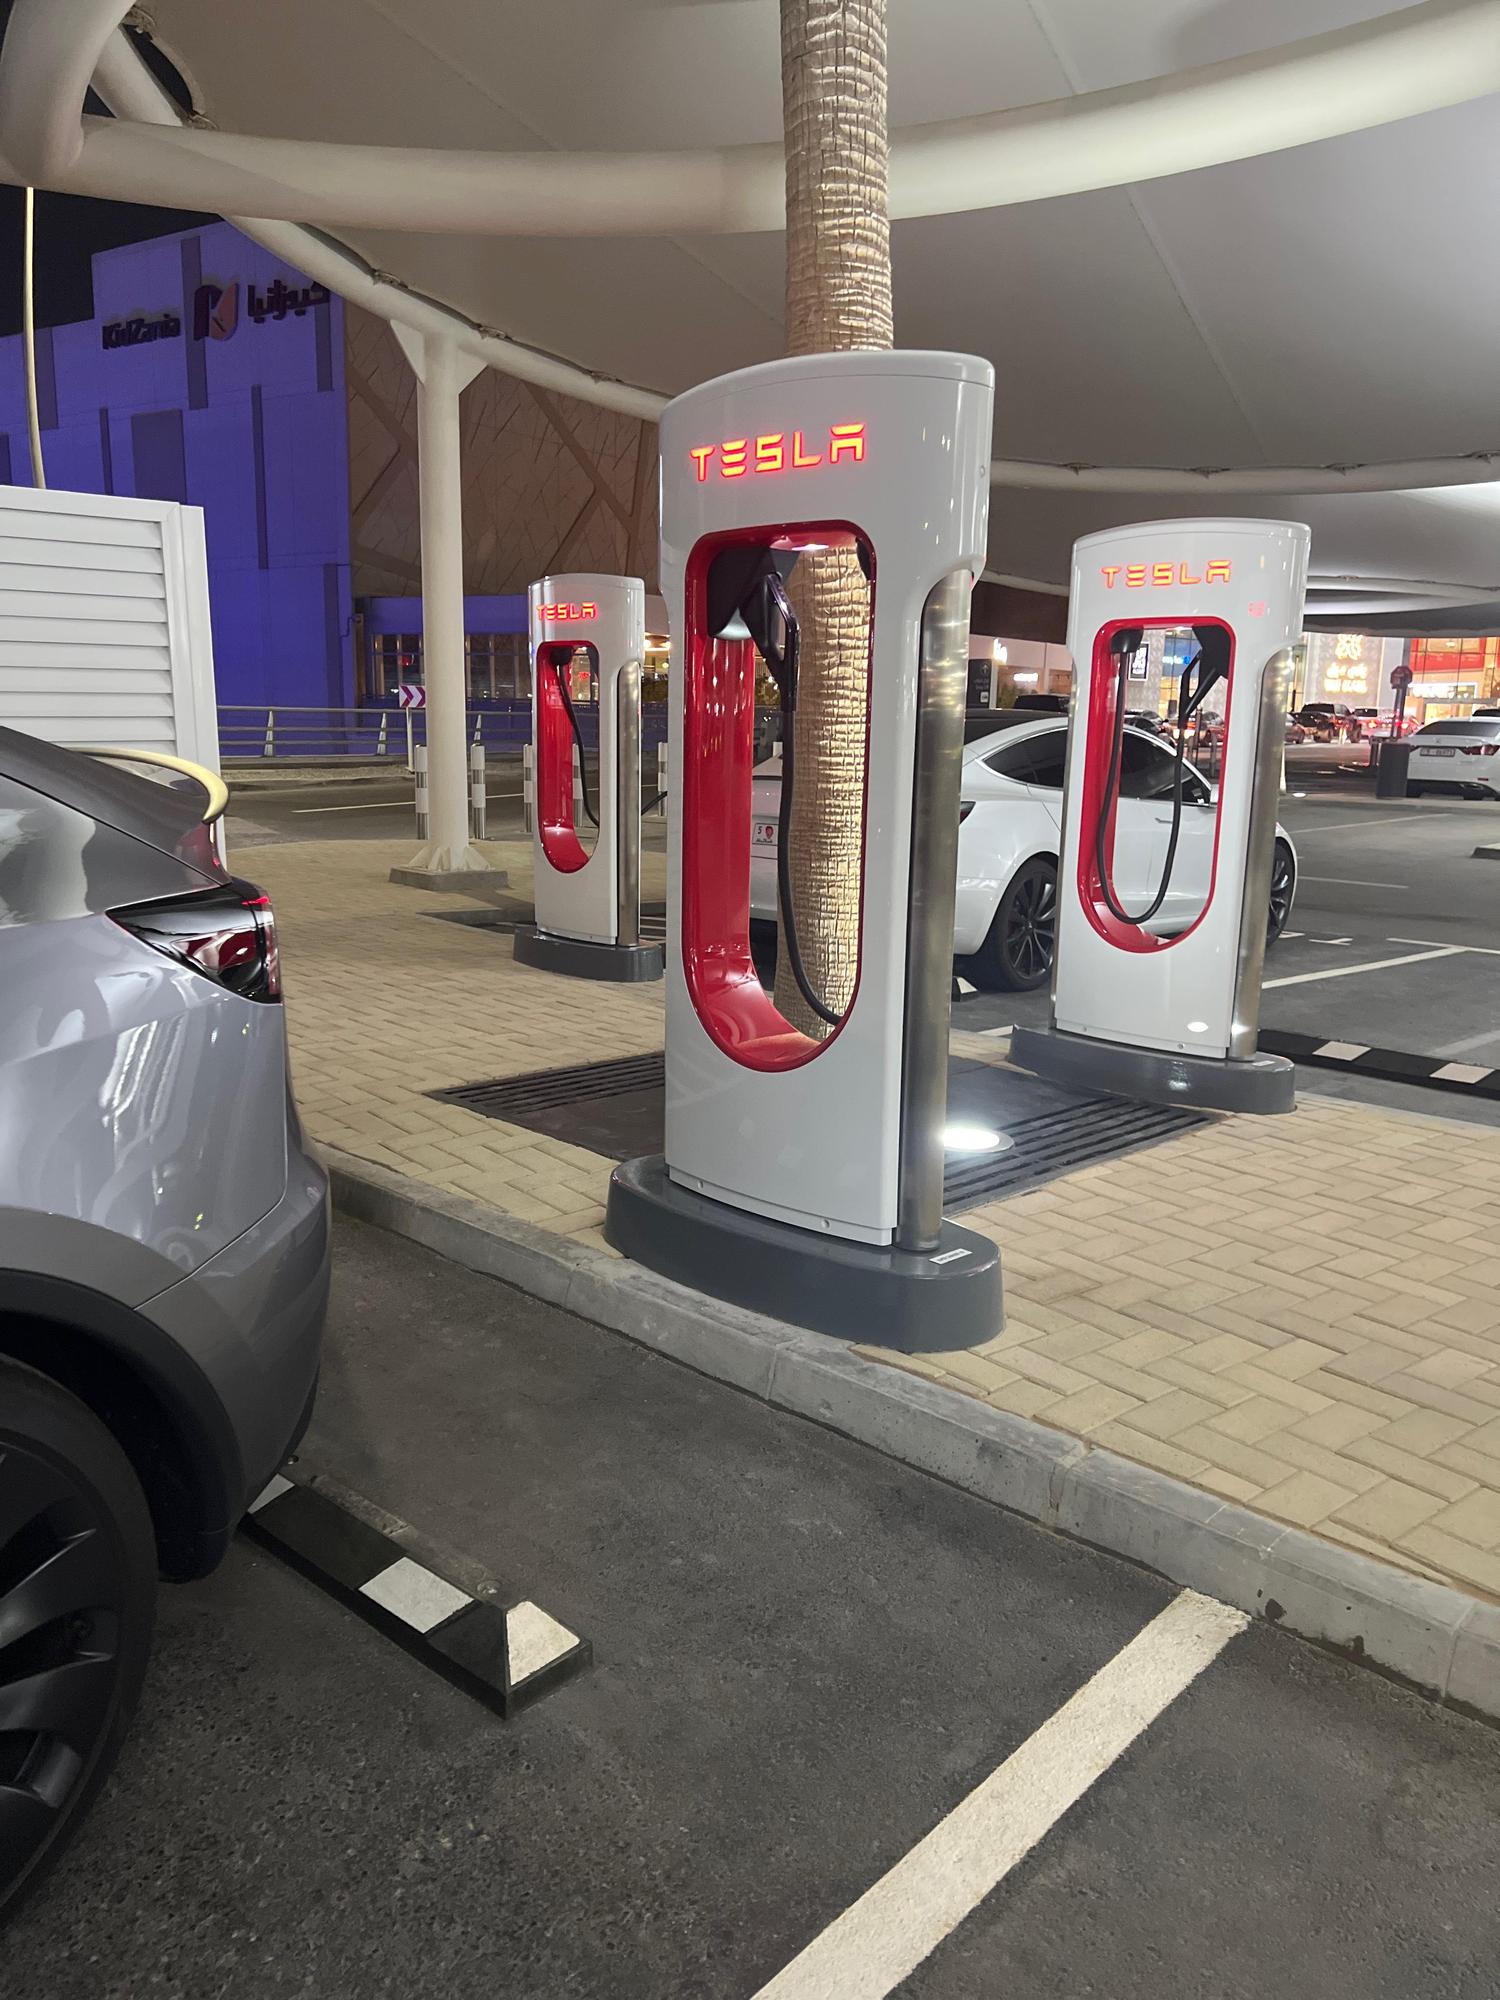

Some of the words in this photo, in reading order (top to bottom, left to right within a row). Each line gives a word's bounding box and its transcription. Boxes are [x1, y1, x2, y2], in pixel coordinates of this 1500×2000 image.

[102, 313, 181, 350] KidZania
[690, 423, 864, 482] TESLA
[1101, 560, 1231, 589] TESLA
[536, 602, 595, 620] TESLA
